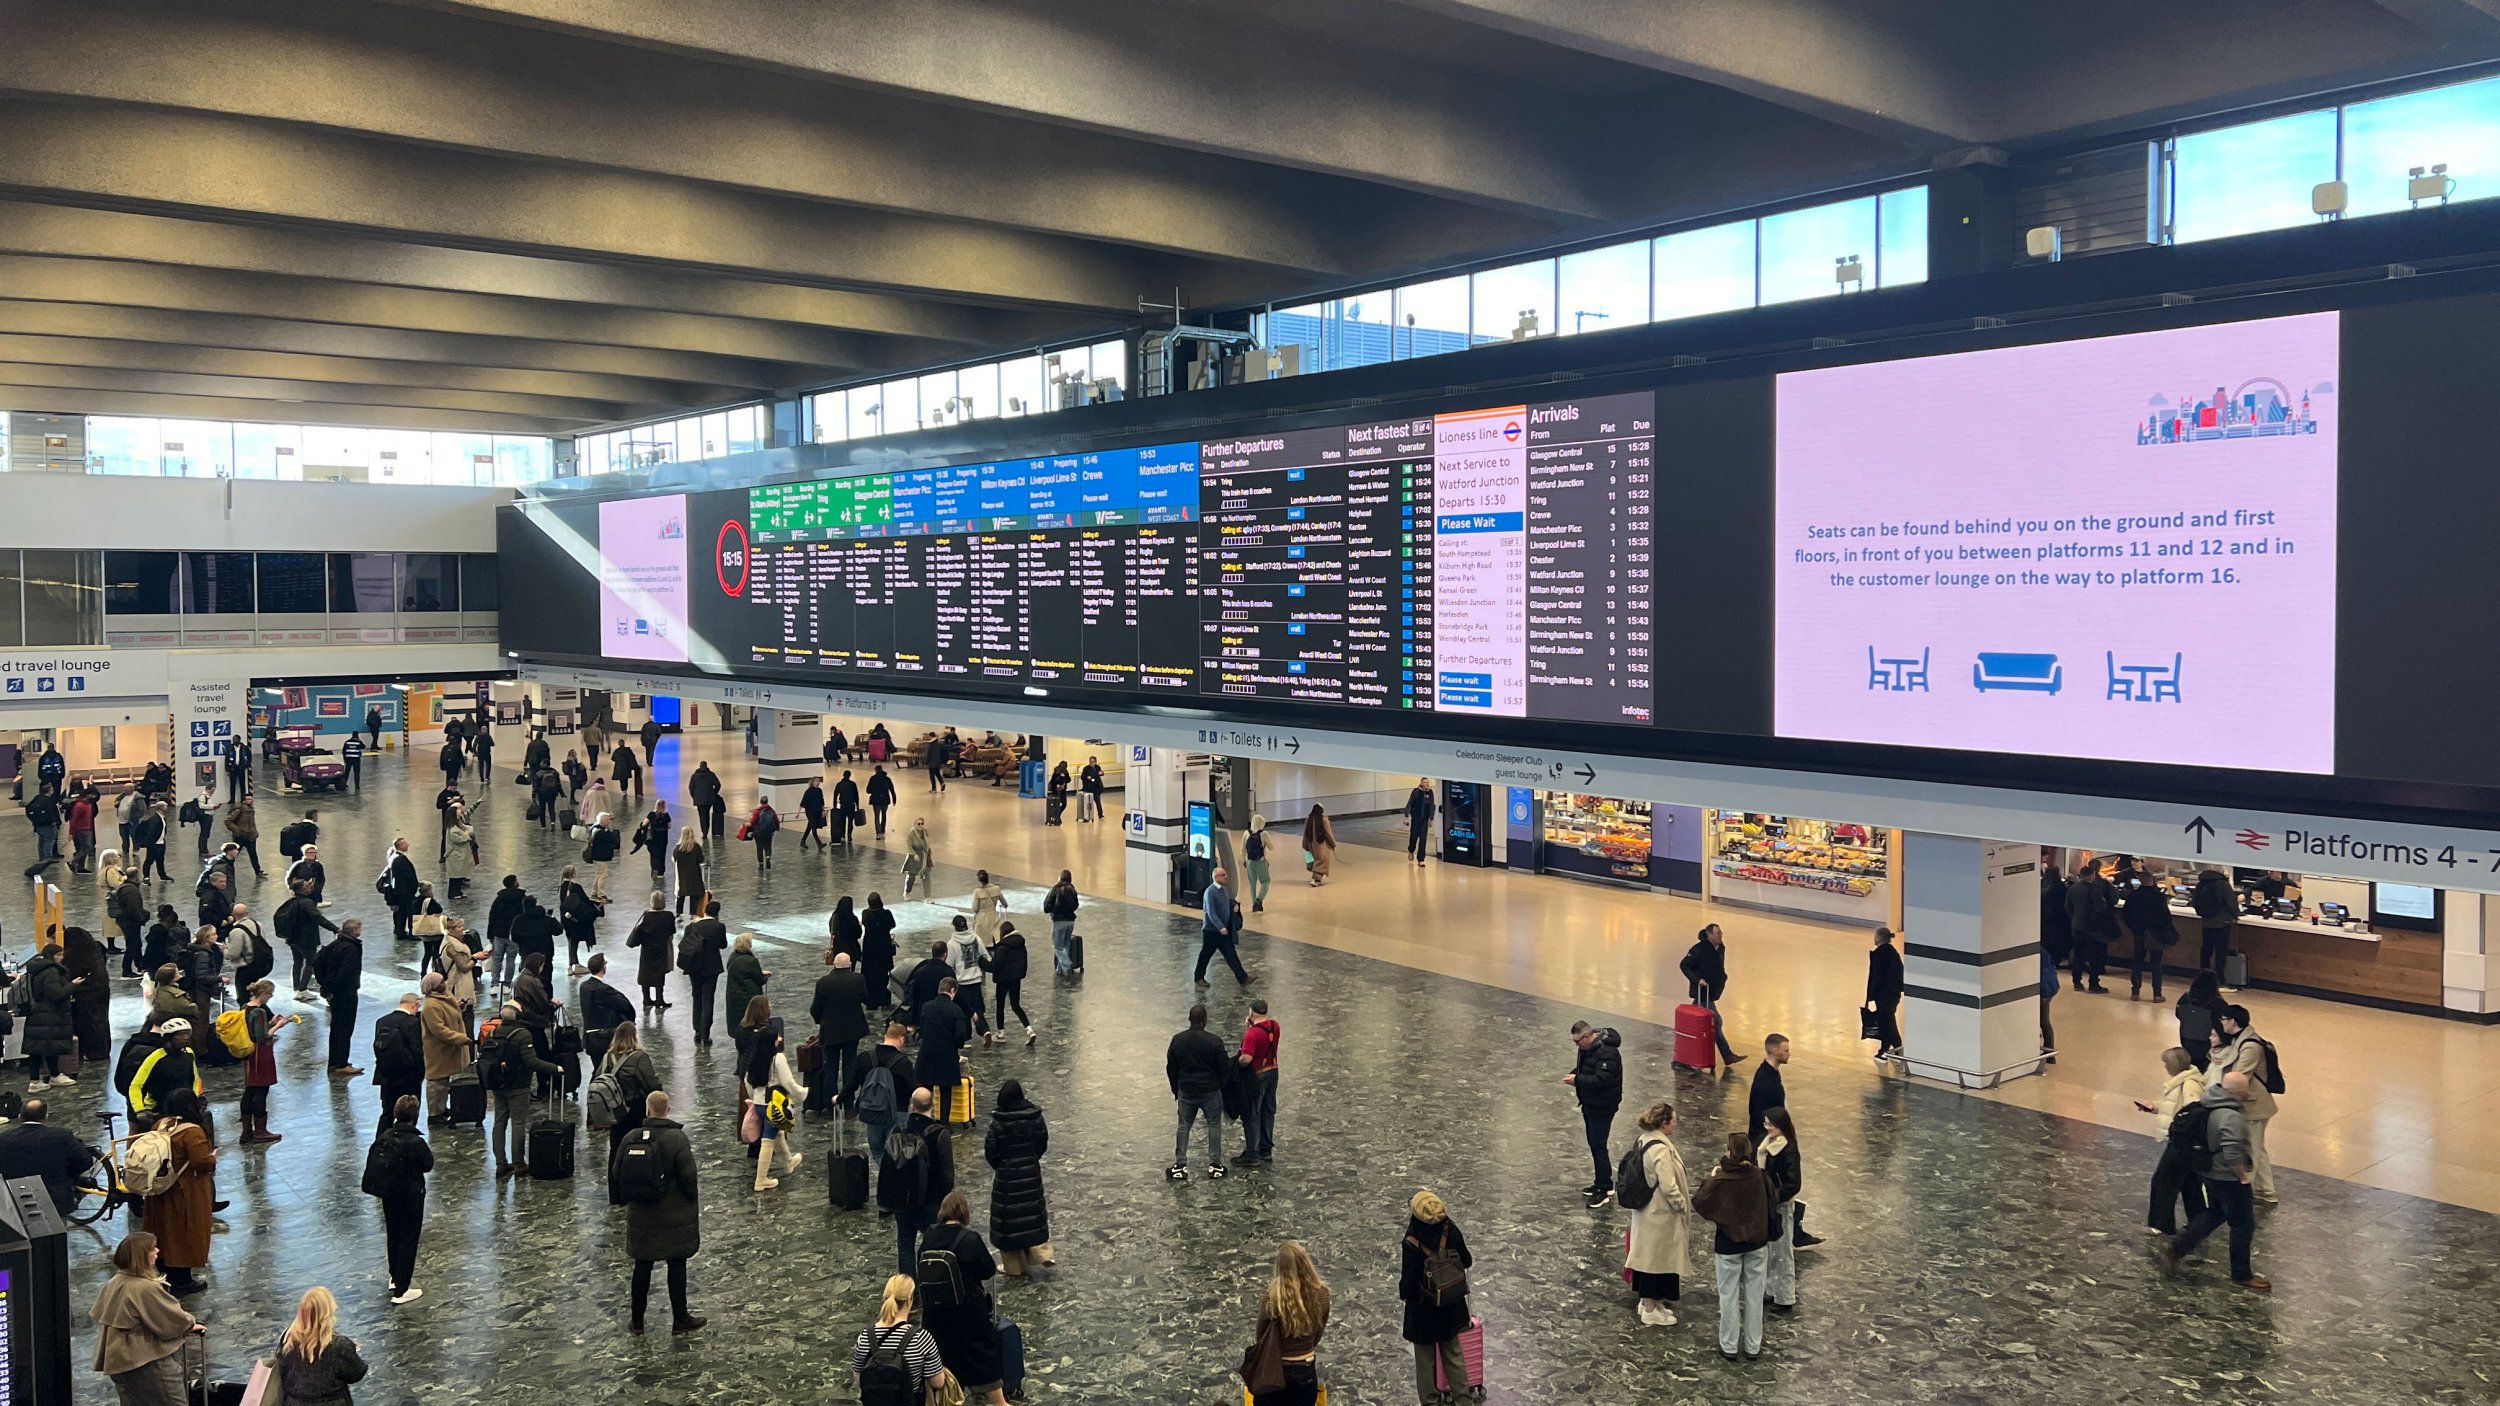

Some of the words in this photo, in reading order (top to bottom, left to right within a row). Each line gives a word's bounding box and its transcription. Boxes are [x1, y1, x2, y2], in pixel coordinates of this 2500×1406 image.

[1530, 404, 1580, 424] Arrivals
[1414, 424, 1418, 432] 2
[1419, 424, 1424, 432] of
[1424, 422, 1430, 431] 4
[1600, 423, 1616, 433] Plat
[1633, 420, 1650, 430] Due
[1348, 428, 1372, 442] Next
[1374, 424, 1410, 440] fastest
[1440, 432, 1476, 443] Lioness
[1480, 428, 1498, 440] line
[1530, 430, 1550, 440] From
[1202, 443, 1234, 457] Further
[1235, 438, 1284, 455] Departures
[1348, 446, 1382, 457] Destination
[1398, 442, 1426, 454] Operator
[1530, 450, 1558, 460] Glasgow
[1558, 448, 1582, 457] Central
[1608, 444, 1616, 453] 15
[1628, 442, 1650, 452] 15:28
[1083, 456, 1098, 464] 15:46
[1140, 450, 1156, 459] 15:53
[1322, 450, 1340, 460] Status
[1054, 459, 1078, 468] Preparing
[1140, 464, 1178, 476] Manchester
[1180, 462, 1194, 472] Picc
[1202, 462, 1214, 470] Time
[1220, 459, 1249, 468] Destination
[1440, 461, 1461, 472] Next
[1464, 459, 1496, 470] Service
[1500, 458, 1510, 468] to
[1530, 465, 1568, 475] Birmingham
[1570, 464, 1584, 472] New
[1586, 462, 1594, 470] St
[1610, 460, 1616, 468] 7
[1628, 458, 1650, 467] 15:15
[1030, 474, 1056, 486] Liverpool
[1056, 474, 1070, 482] Lime
[1070, 472, 1077, 482] St
[1082, 471, 1103, 480] Crewe
[1221, 478, 1232, 486] Tring
[1439, 478, 1476, 490] Watford
[1479, 476, 1520, 488] Junction
[1530, 480, 1556, 490] Watford
[1557, 478, 1584, 488] Junction
[1610, 476, 1616, 484] 9
[1628, 474, 1649, 483] 15:21
[1082, 494, 1098, 502] Please
[1140, 490, 1156, 498] Please
[1530, 496, 1546, 506] Tring
[1608, 492, 1616, 500] 11
[1628, 490, 1650, 499] 15:22
[1440, 497, 1474, 510] Departs
[1480, 494, 1506, 506] 15:30
[1148, 506, 1166, 514] AVANTI
[1530, 512, 1552, 520] Crewe
[1610, 508, 1616, 516] 4
[1628, 506, 1650, 515] 15:28
[1162, 514, 1179, 522] COAST
[1442, 518, 1471, 529] Please
[1473, 517, 1496, 528] Wait
[1808, 525, 1846, 538] Seats
[1850, 524, 1876, 537] can
[1880, 522, 1899, 536] be
[1904, 520, 1950, 536] found
[1955, 518, 2012, 534] behind
[2017, 520, 2048, 535] you
[2054, 519, 2076, 532] on
[2082, 515, 2112, 530] the
[2116, 512, 2184, 533] ground
[2190, 510, 2228, 526] and
[2234, 509, 2276, 526] first
[1530, 525, 1567, 534] Manchester
[1568, 524, 1582, 533] Picc
[1610, 523, 1616, 532] 3
[1628, 522, 1649, 531] 15:32
[1530, 540, 1559, 550] Liverpool
[1560, 540, 1577, 549] Lime
[1578, 540, 1585, 548] St
[1611, 539, 1616, 547] 1
[1628, 538, 1649, 547] 15:35
[1795, 548, 1840, 564] floors,
[1844, 548, 1857, 562] in
[1862, 547, 1900, 562] front
[1904, 546, 1920, 560] of
[1924, 548, 1953, 564] you
[1958, 545, 2032, 560] between
[2037, 542, 2124, 562] platforms
[2130, 541, 2150, 557] 11
[2158, 540, 2193, 556] and
[2200, 539, 2224, 556] 12
[2230, 538, 2268, 554] and
[2276, 537, 2295, 554] in
[722, 551, 742, 566] 15:15
[1530, 556, 1554, 564] Chester
[1610, 554, 1616, 563] 2
[1627, 554, 1649, 562] 15:39
[1530, 570, 1556, 579] Watford
[1556, 570, 1584, 579] Junction
[1610, 570, 1616, 578] 9
[1830, 572, 1854, 586] the
[1858, 572, 1930, 586] customer
[1936, 570, 1990, 588] lounge
[1995, 573, 2016, 586] on
[2021, 570, 2050, 586] the
[2055, 571, 2091, 588] way
[2096, 570, 2115, 584] to
[2121, 568, 2204, 588] platform
[2212, 568, 2241, 584] 16.
[1439, 654, 1466, 664] Further
[1468, 656, 1512, 666] Departures
[0, 660, 11, 672] d
[15, 659, 57, 672] travel
[62, 659, 110, 675] lounge
[1440, 676, 1462, 684] Please
[1464, 677, 1479, 685] wait
[1504, 679, 1523, 687] 15:45
[190, 683, 230, 693] Assisted
[737, 689, 754, 699] Toilets
[197, 694, 224, 703] travel
[845, 698, 872, 710] Platforms
[873, 700, 877, 710] 8
[882, 701, 886, 711] 11
[1440, 693, 1462, 701] Please
[1464, 695, 1479, 703] wait
[1504, 697, 1523, 705] 15:57
[194, 704, 227, 714] lounge
[1622, 706, 1649, 716] infotec
[1230, 731, 1262, 748] Toilets
[1456, 750, 1494, 762] Caledonian
[1496, 753, 1523, 765] Sleeper
[1526, 755, 1542, 766] Club
[1495, 769, 1514, 779] guest
[1517, 770, 1542, 782] lounge
[2285, 830, 2428, 866] Platforms
[2438, 846, 2457, 869] 4
[2489, 850, 2500, 873] 7
